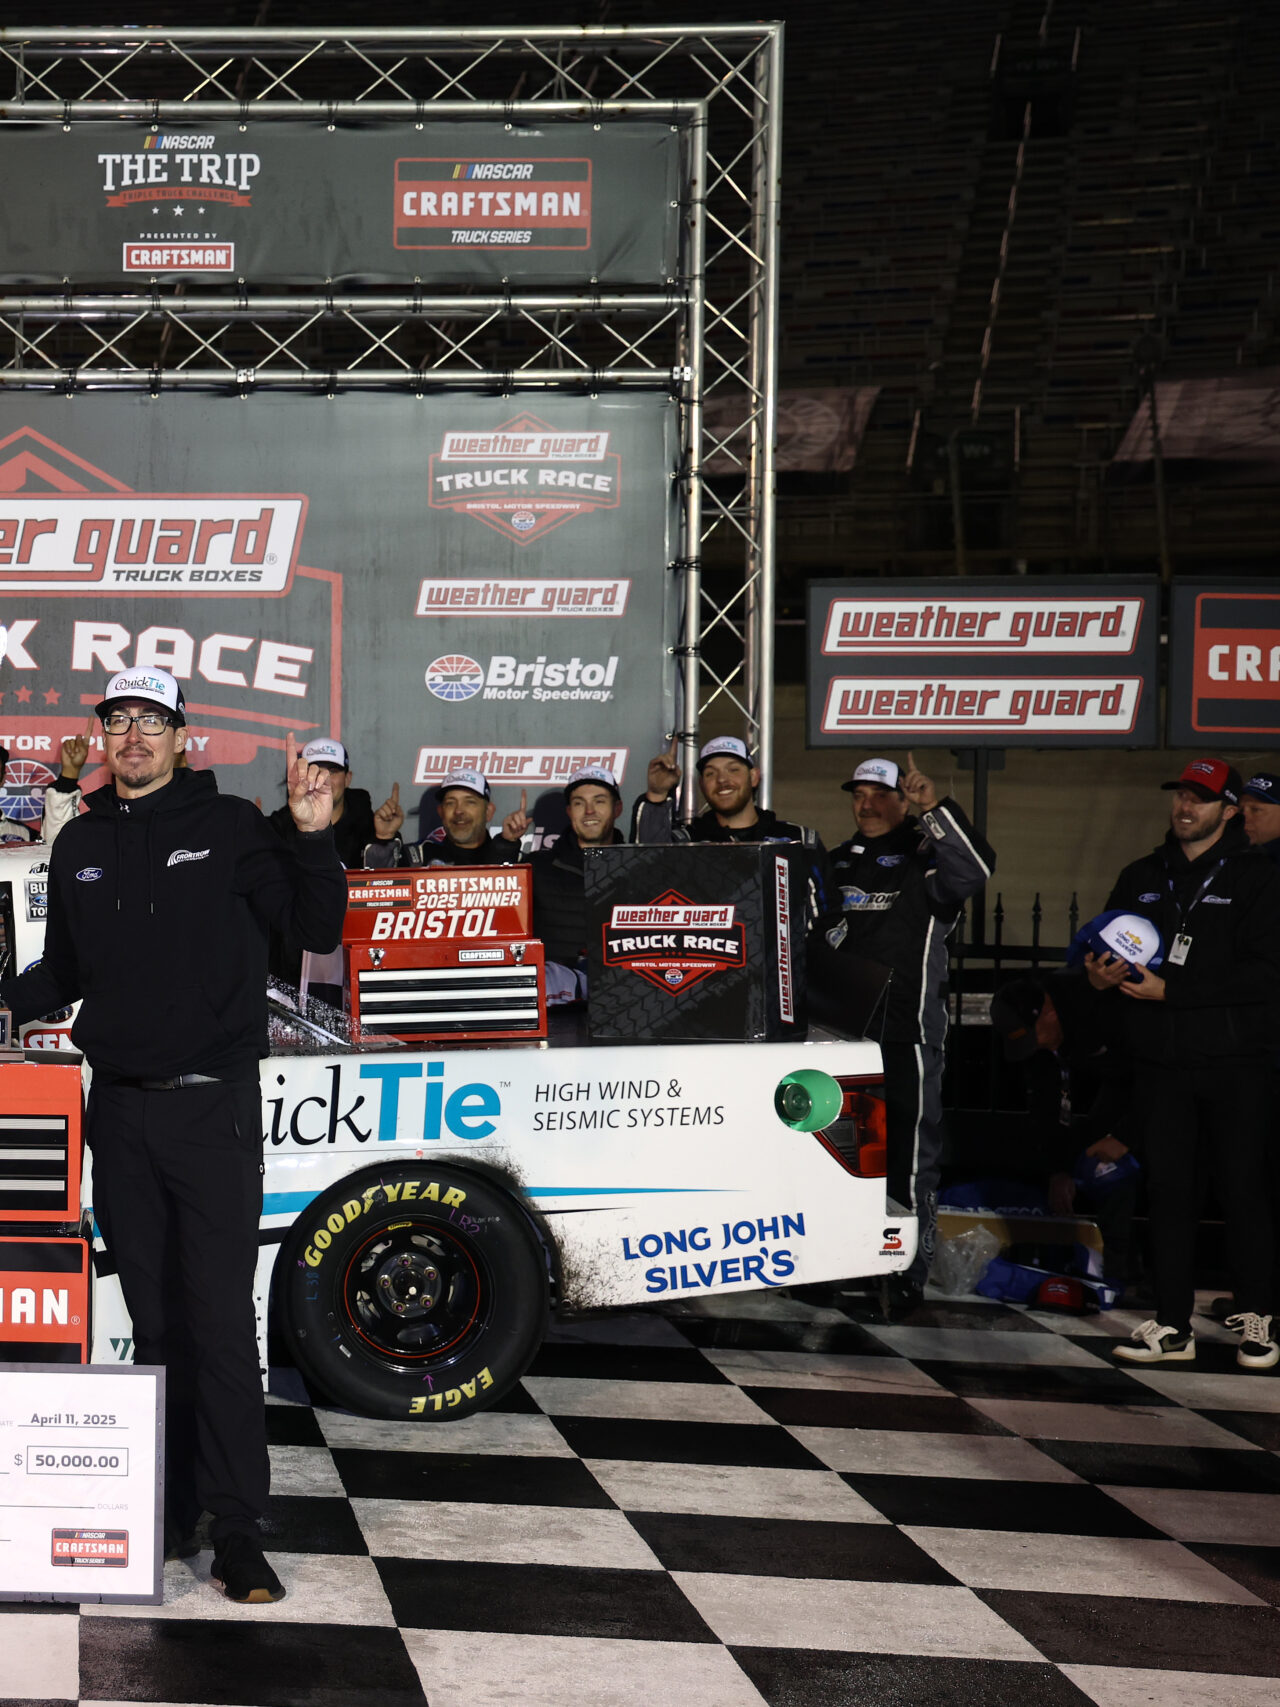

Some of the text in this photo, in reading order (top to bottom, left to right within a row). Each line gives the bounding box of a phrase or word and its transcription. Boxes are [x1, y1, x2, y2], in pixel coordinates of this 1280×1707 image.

[161, 135, 215, 149] NASCAR
[97, 153, 261, 191] THE TRIP
[472, 164, 534, 179] NASCAR
[403, 192, 581, 217] CRAFTSMAN
[451, 230, 532, 243] TRUCK SERIES
[130, 250, 227, 265] CRAFTSMAN
[449, 435, 600, 457] weather guard
[436, 469, 613, 492] TRUCK RACE
[73, 508, 275, 582] guard
[112, 570, 263, 582] TRUCK BOXES
[426, 583, 619, 611] weather guard
[839, 605, 1125, 647] weather guard
[72, 620, 314, 697] RACE
[486, 656, 619, 686] Bristol
[115, 676, 166, 693] QuickTie
[483, 687, 611, 702] Motor Speedway
[839, 684, 1124, 725] weather guard
[424, 752, 533, 773] weather
[539, 752, 616, 779] guard
[349, 888, 410, 898] CRAFTSMAN
[416, 876, 518, 893] CRAFTSMAN
[416, 892, 521, 909] 2025 WINNER
[371, 909, 498, 940] BRISTOL
[616, 908, 728, 926] weather guard
[608, 935, 739, 954] TRUCK RACE
[777, 865, 790, 1015] weather guard
[263, 1061, 682, 1146] ickTie HIGH WIND &
[533, 1106, 725, 1131] SEISMIC SYSTEMS
[304, 1181, 467, 1267] GOODYEAR
[622, 1212, 806, 1260] LONG JOHN
[645, 1247, 795, 1293] SILVER'S
[409, 1366, 494, 1414] EAGLE
[31, 1413, 61, 1427] April
[65, 1414, 78, 1425] 11,
[83, 1414, 116, 1425] 2025
[14, 1453, 119, 1468] $ 50,000.00
[55, 1542, 124, 1554] CRAFTSMAN
